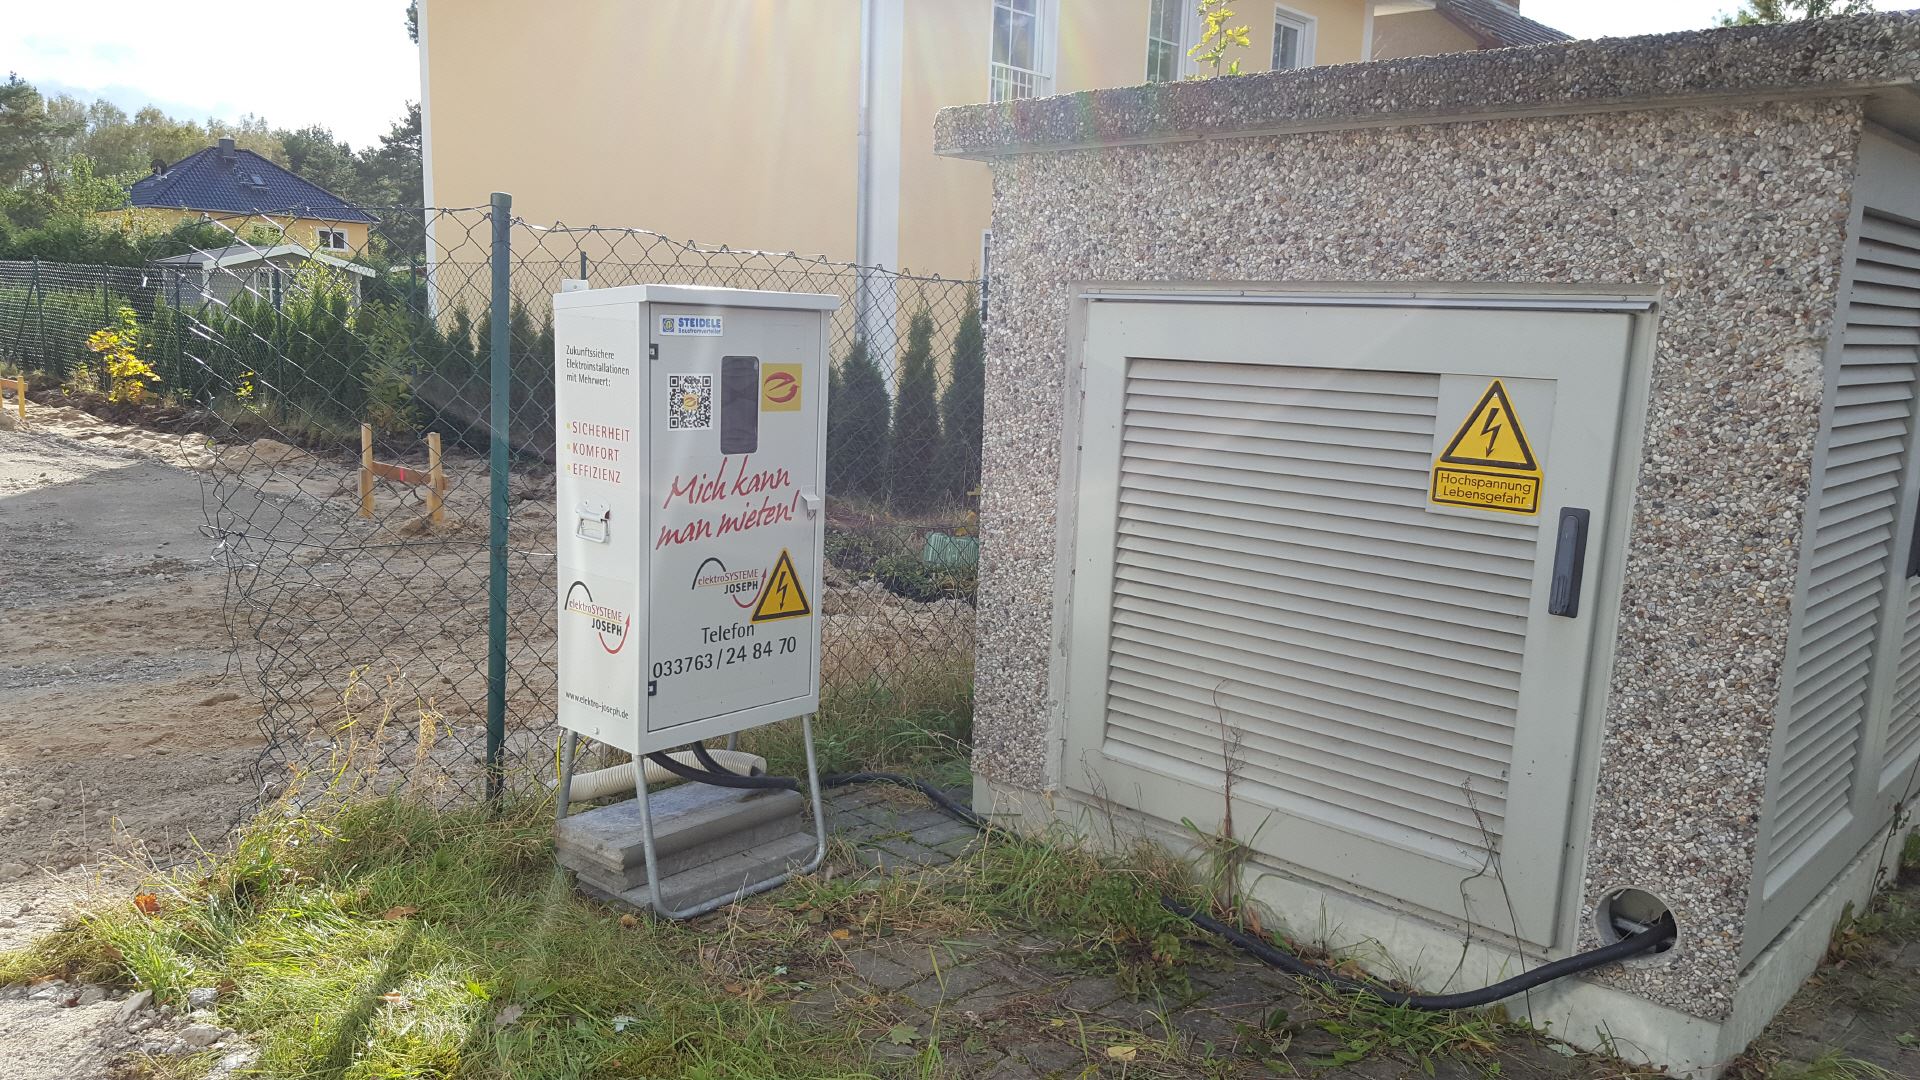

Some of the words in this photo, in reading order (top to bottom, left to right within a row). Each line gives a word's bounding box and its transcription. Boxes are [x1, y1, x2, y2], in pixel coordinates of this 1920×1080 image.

[678, 317, 721, 328] STEIDELE
[565, 344, 615, 360] Zukunftssichere
[566, 358, 630, 376] Elektroinstallationen
[566, 373, 577, 383] mit
[578, 373, 611, 387] Mehrwert:
[572, 421, 630, 443] SICHERHEIT
[572, 442, 620, 462] KOMFORT
[573, 463, 621, 484] EFFIZIENZ
[663, 456, 727, 509] Mich
[730, 454, 790, 496] kann
[1440, 473, 1531, 495] Hochspannung
[1443, 486, 1526, 505] Lebensgefahr
[655, 524, 712, 550] man
[715, 489, 801, 538] mieten!
[723, 580, 759, 595] JOSEPH
[591, 617, 622, 637] JOSEPH
[701, 622, 755, 645] Telefon
[752, 640, 773, 660] 84
[778, 636, 797, 655] 70
[565, 691, 629, 720] www.elektro-joseph.de
